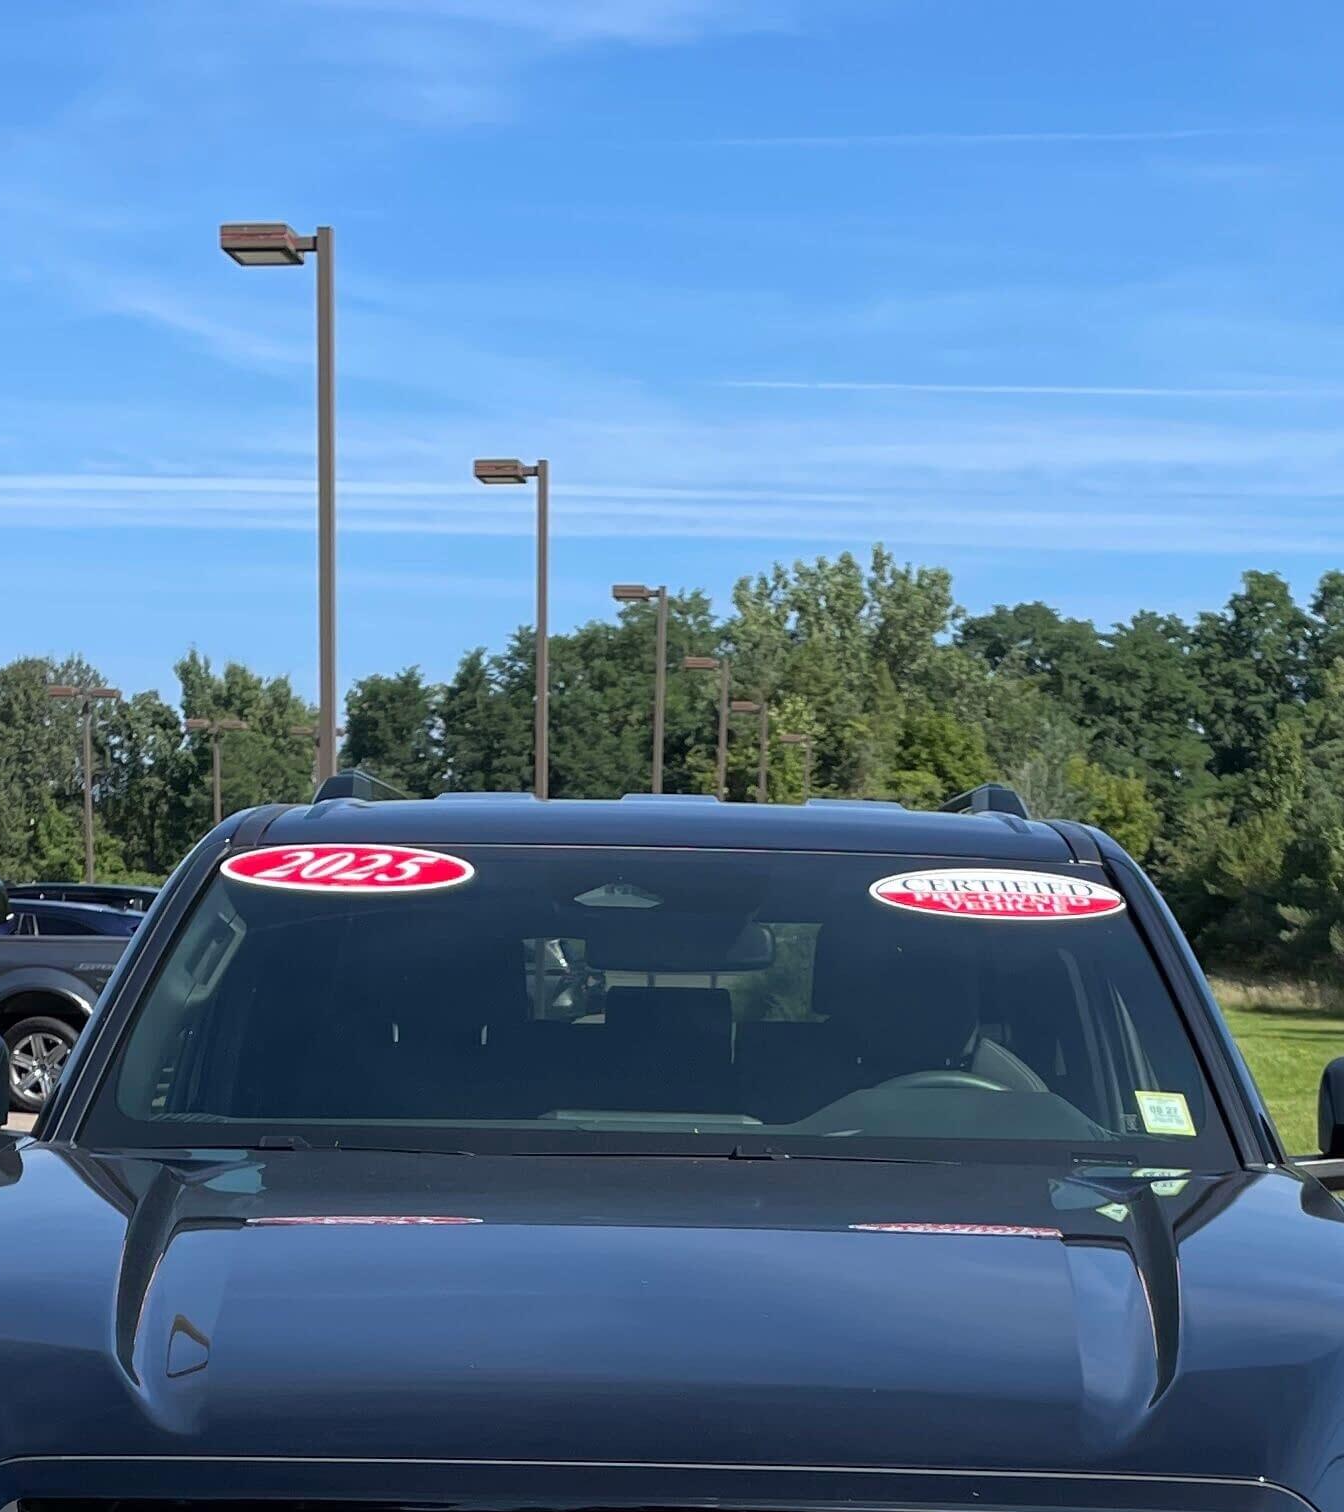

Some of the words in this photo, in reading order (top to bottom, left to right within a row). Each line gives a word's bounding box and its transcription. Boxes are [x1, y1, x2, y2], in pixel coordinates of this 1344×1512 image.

[253, 850, 441, 882] 2025
[901, 878, 1093, 898] CERTIFIED
[912, 891, 1091, 907] PRE-OWNED
[941, 898, 1069, 913] VEHICLE
